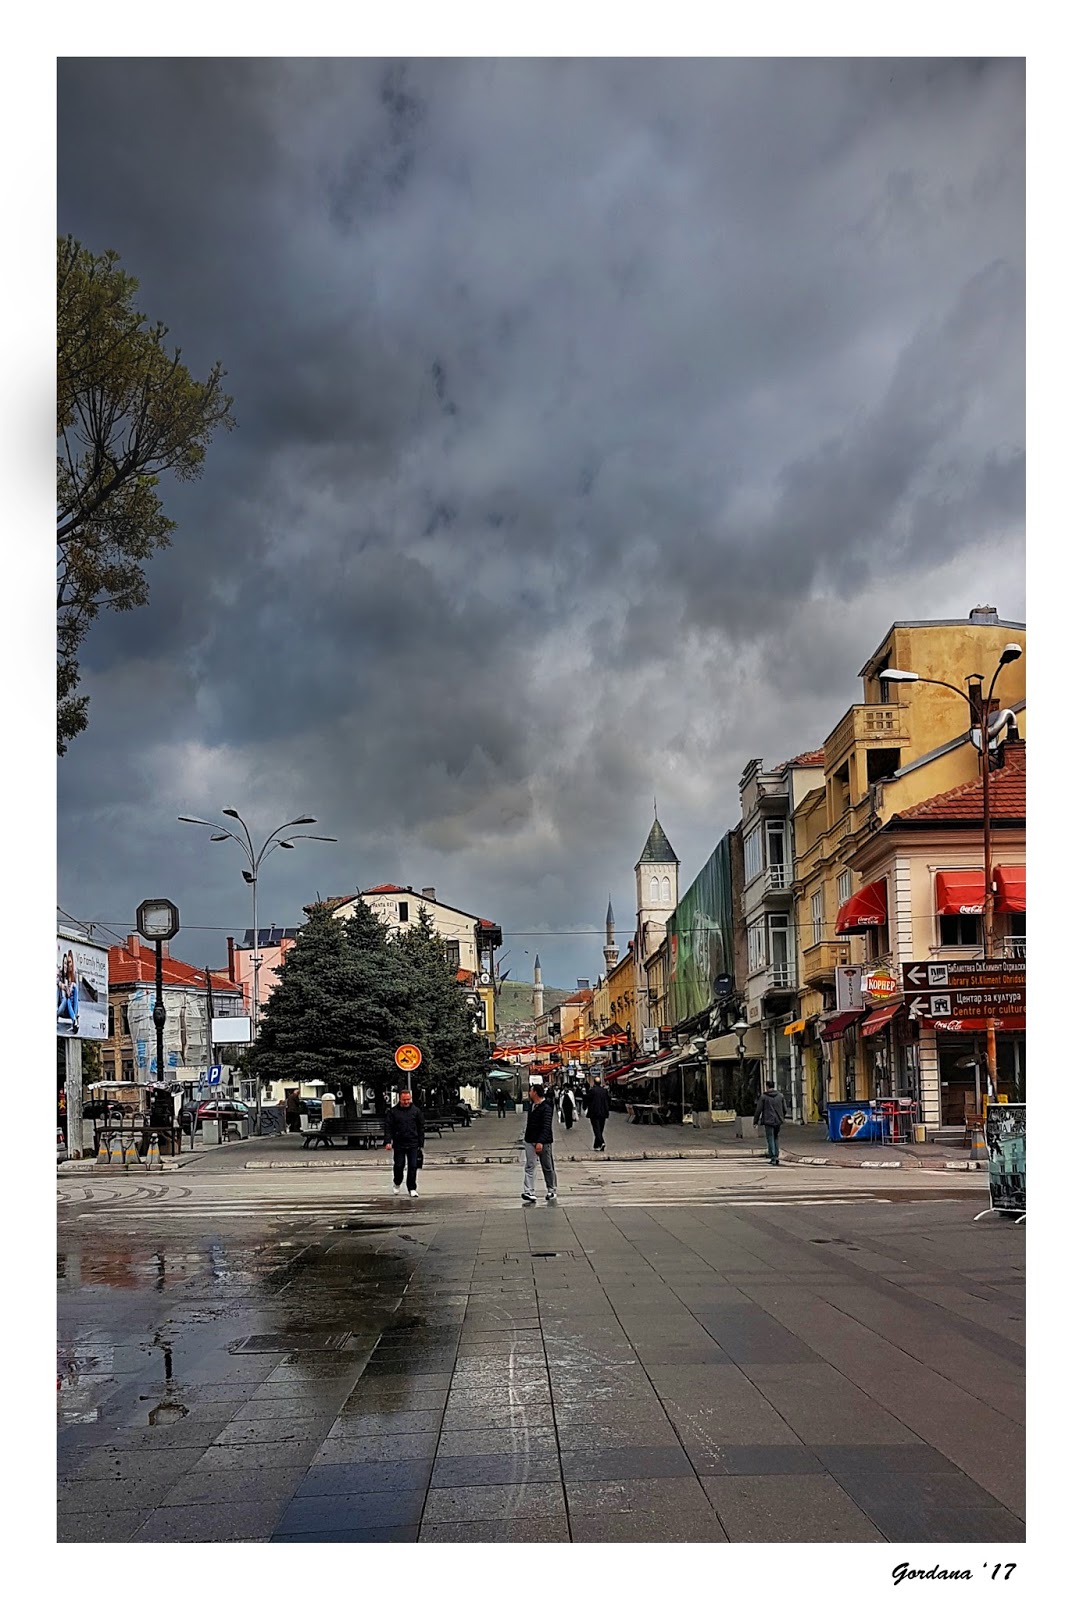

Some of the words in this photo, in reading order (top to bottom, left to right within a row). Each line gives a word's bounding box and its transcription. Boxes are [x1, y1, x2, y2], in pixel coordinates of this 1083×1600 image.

[868, 978, 896, 991] КОРНЕР
[948, 976, 969, 987] Library
[956, 993, 982, 1005] Центар
[993, 992, 1021, 1003] култура
[953, 1006, 981, 1017] Centre
[983, 1005, 996, 1015] for
[998, 1004, 1026, 1014] culture
[210, 1068, 218, 1082] P
